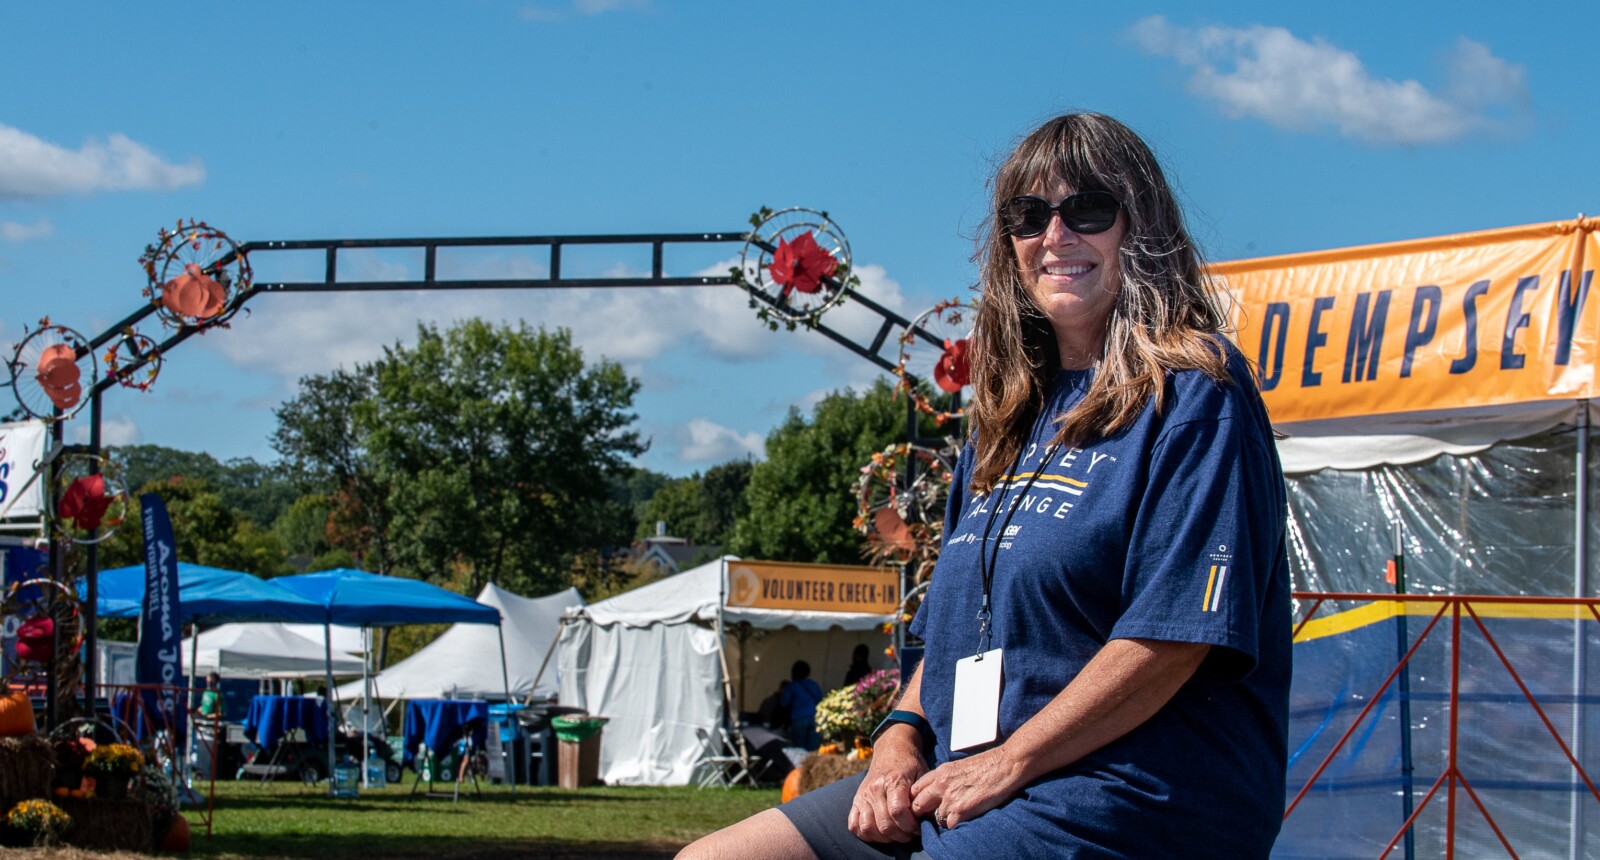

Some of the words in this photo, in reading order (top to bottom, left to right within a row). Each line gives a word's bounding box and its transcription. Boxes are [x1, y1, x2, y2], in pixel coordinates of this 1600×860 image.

[1259, 270, 1595, 391] DEMPSEY
[144, 507, 154, 540] FIND
[147, 541, 158, 580] YOUR
[157, 540, 172, 641] Aroma
[762, 579, 834, 602] VOLUNTEER
[838, 582, 896, 604] CHECK-IN
